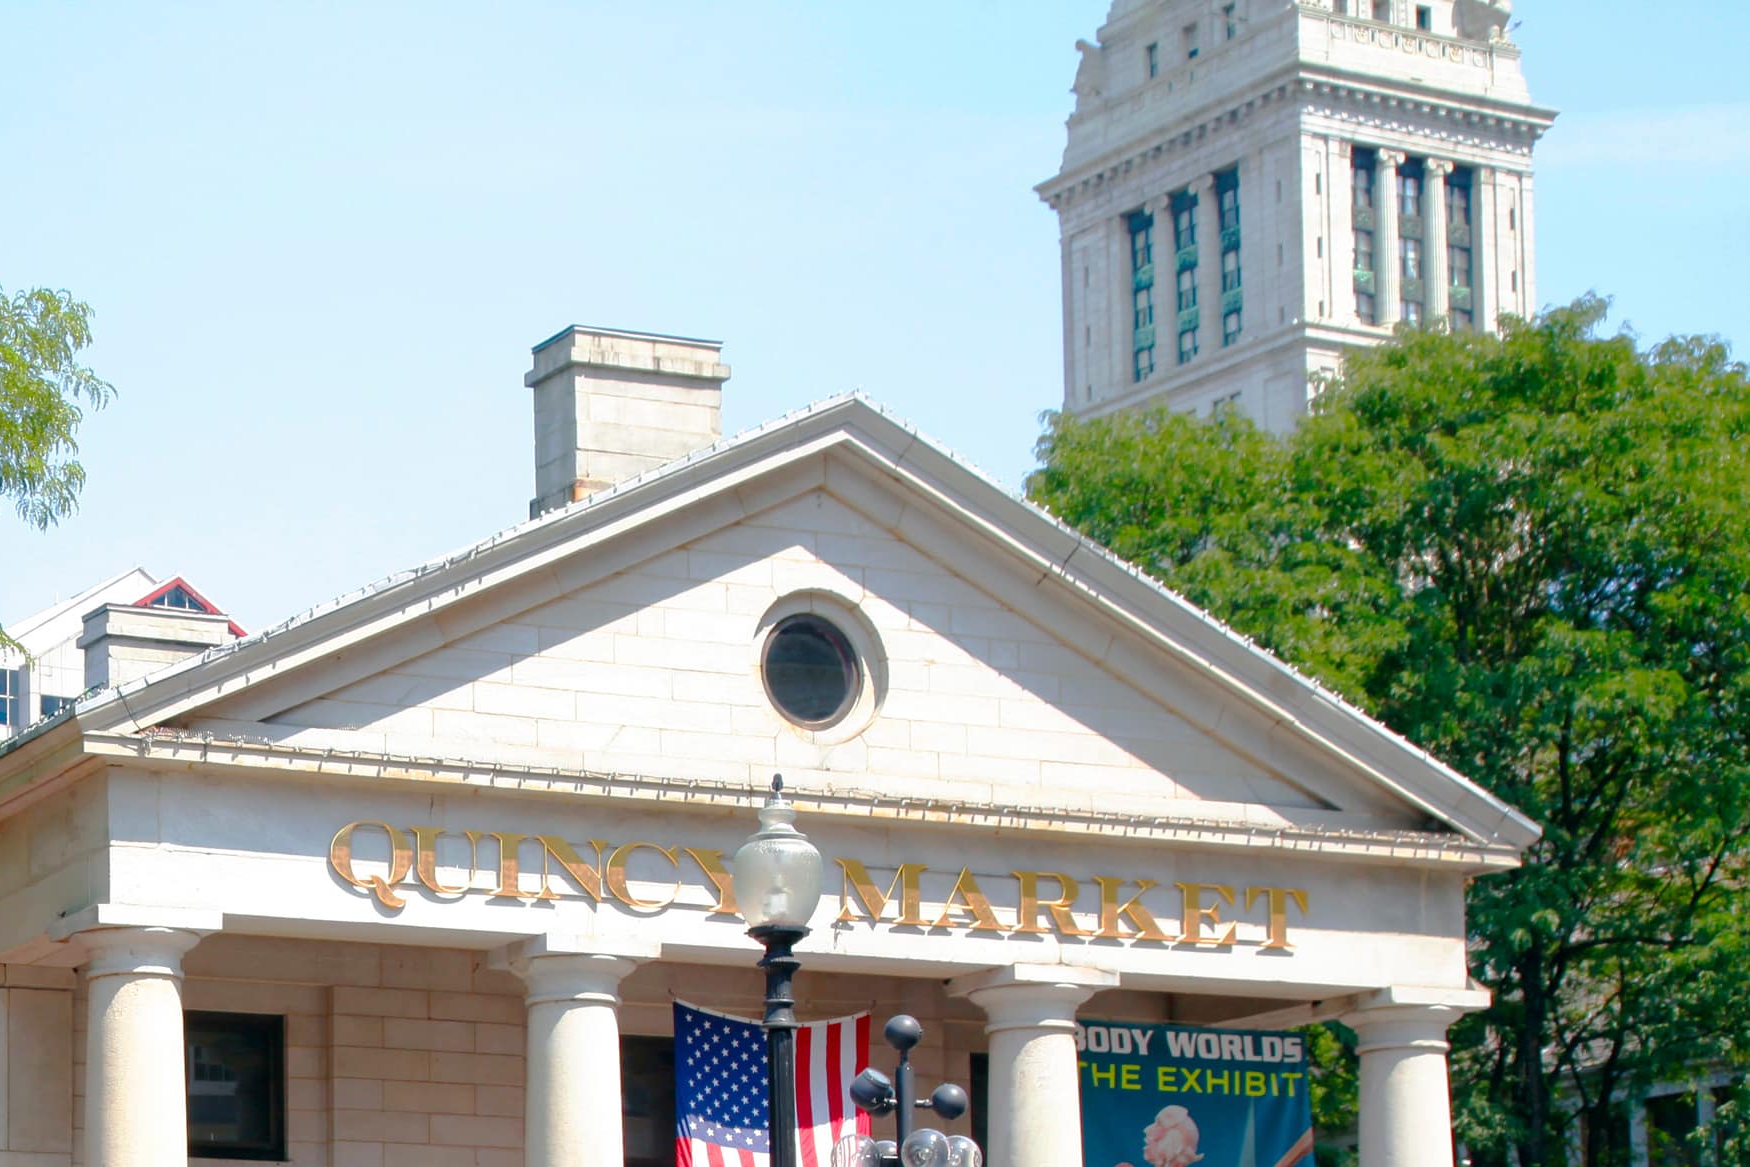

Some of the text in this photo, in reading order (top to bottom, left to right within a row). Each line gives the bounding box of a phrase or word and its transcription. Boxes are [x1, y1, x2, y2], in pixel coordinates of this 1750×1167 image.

[837, 857, 1309, 950] MARKET
[1166, 1031, 1303, 1063] WORLDS
[1158, 1066, 1303, 1097] EXHIBIT
